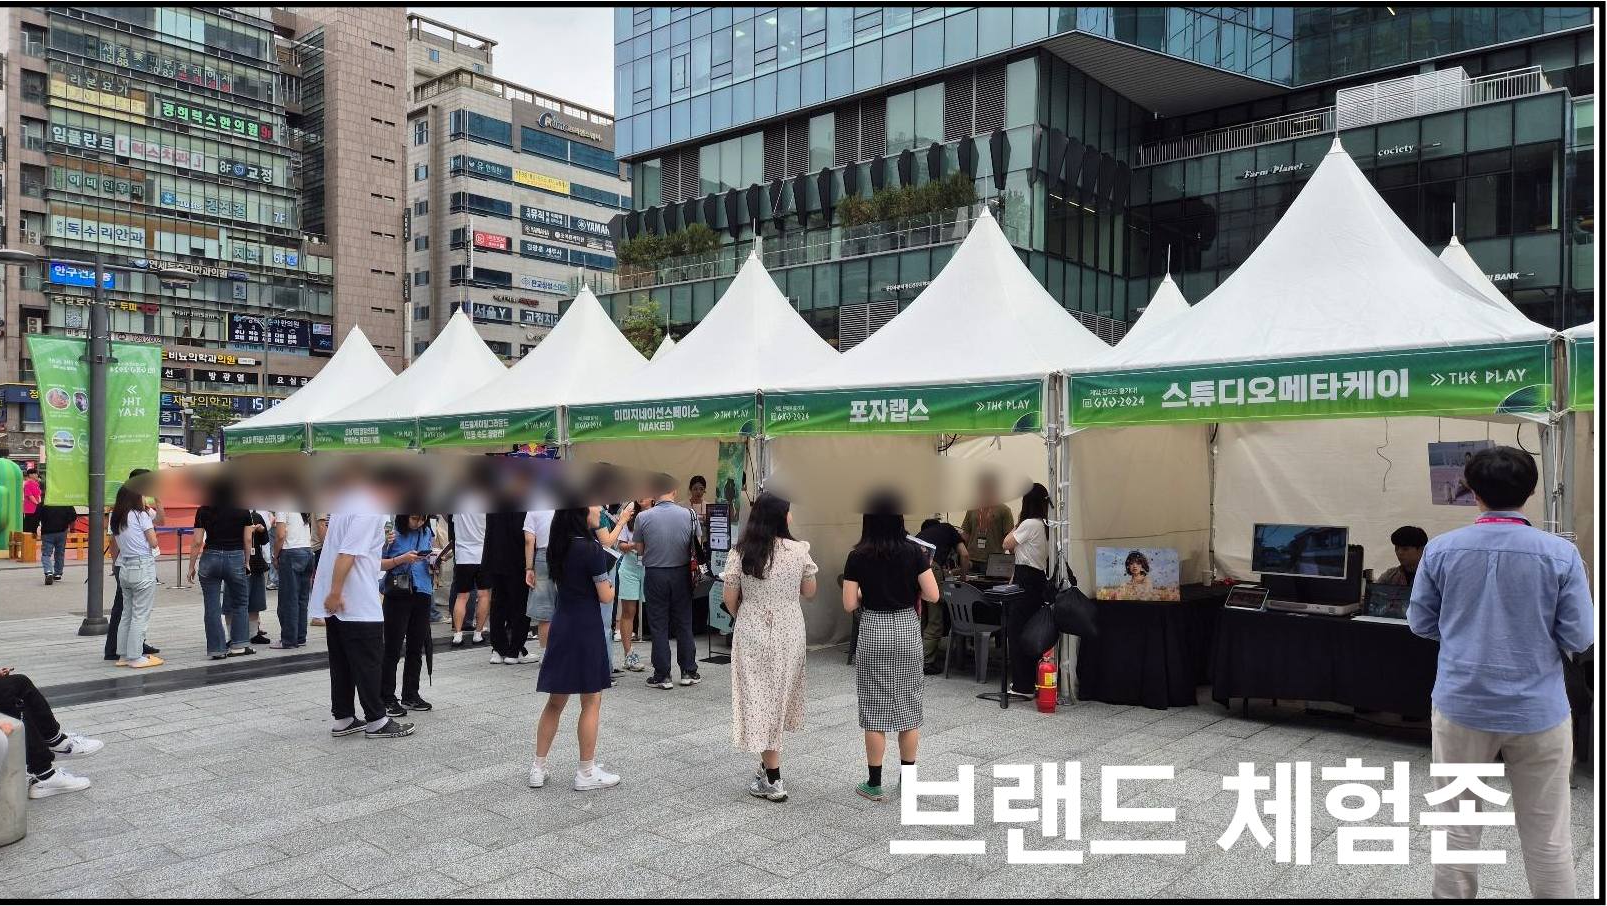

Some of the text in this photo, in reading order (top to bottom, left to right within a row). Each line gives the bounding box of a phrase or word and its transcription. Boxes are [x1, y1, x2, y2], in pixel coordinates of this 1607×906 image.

[51, 126, 114, 151] 임플란트
[246, 165, 273, 183] 교정
[68, 173, 143, 197] 이비인후과
[67, 222, 143, 244] 독수리안과
[586, 220, 610, 236] YAMAH
[1448, 368, 1527, 386] THE PLAY
[1161, 367, 1410, 409] 스튜디오메타케이
[614, 405, 700, 422] 이미지네이션스페이스
[850, 398, 930, 423] 포자랩스
[986, 399, 1030, 411] THE PLAY
